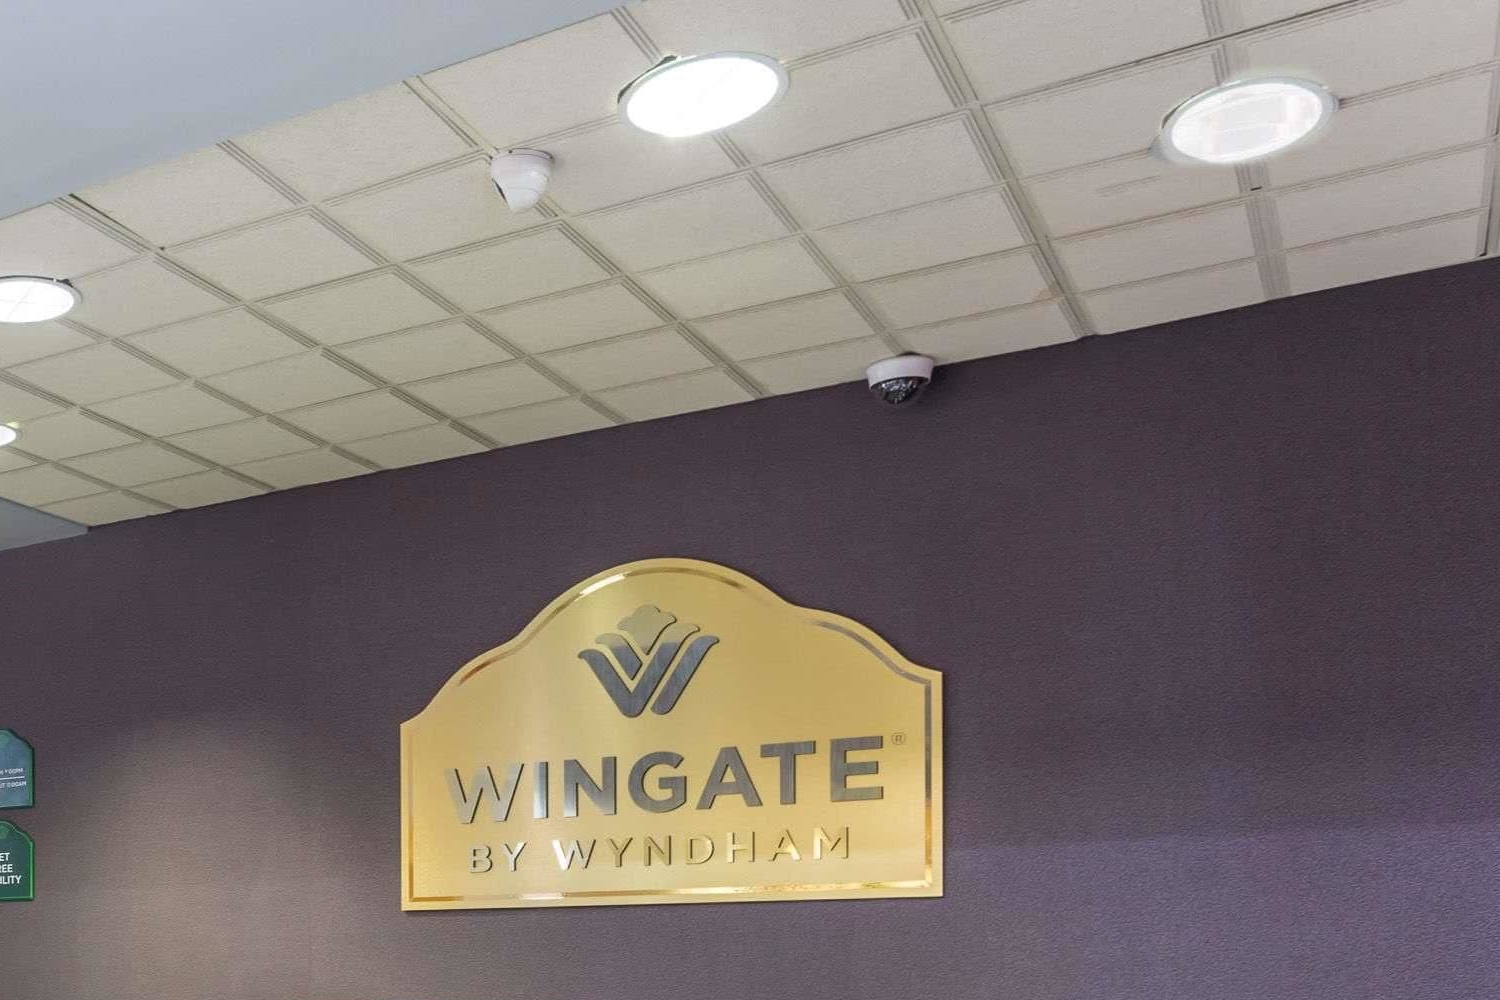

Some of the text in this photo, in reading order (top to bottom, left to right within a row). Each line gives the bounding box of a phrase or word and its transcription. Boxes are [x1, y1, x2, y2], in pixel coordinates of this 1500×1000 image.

[447, 734, 885, 824] WINGATE
[470, 826, 850, 874] BY WYNDHAM
